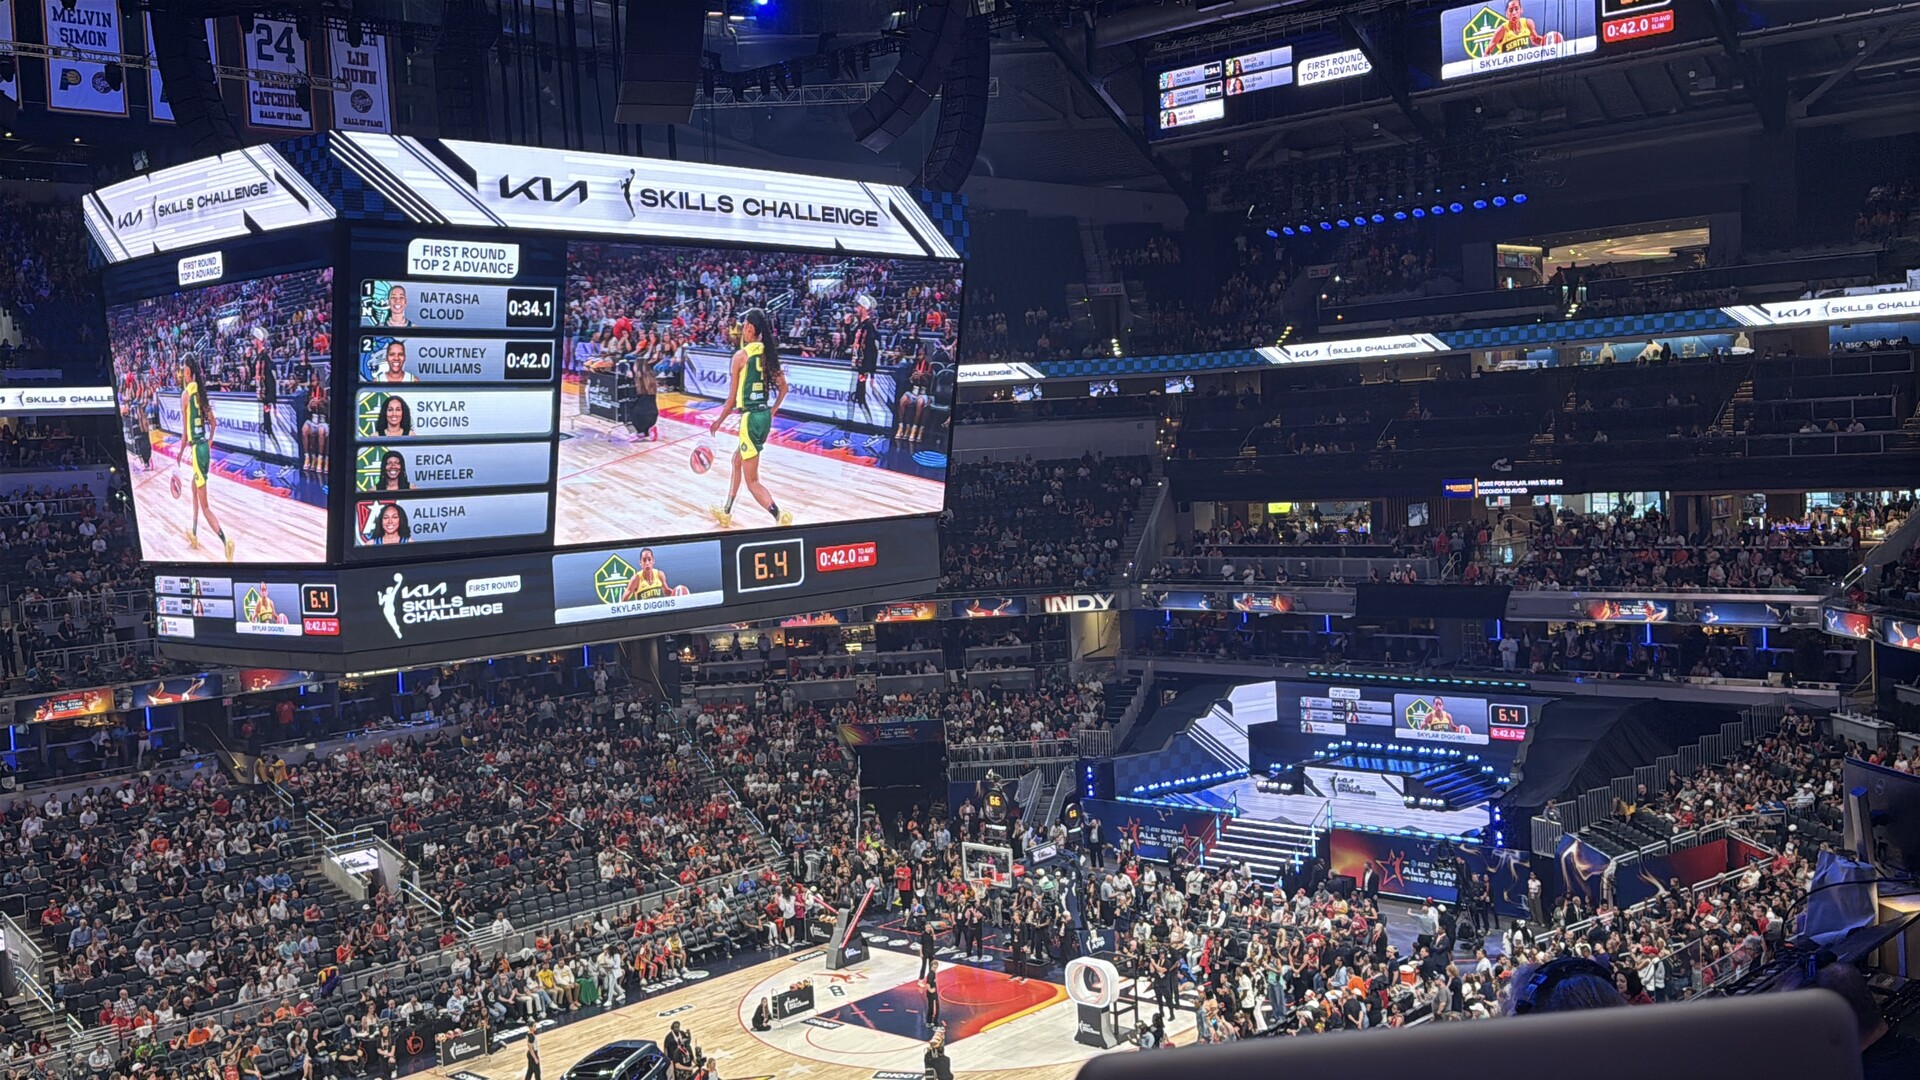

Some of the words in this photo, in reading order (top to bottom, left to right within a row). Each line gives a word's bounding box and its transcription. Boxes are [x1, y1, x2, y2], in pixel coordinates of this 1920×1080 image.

[52, 6, 112, 28] MELVIN
[1607, 19, 1649, 37] 0:42.0
[60, 27, 107, 47] SIMON
[256, 23, 296, 64] 24
[337, 29, 378, 46] COCH
[347, 51, 370, 67] LIN
[1307, 59, 1331, 71] FIRST
[1332, 52, 1364, 65] ROUND
[1479, 55, 1515, 69] SKYLAR
[1517, 47, 1556, 62] DIGGINS
[342, 67, 377, 85] DUNN
[1302, 71, 1319, 82] TOP
[1320, 69, 1326, 78] 2
[1327, 61, 1370, 77] ADVANCE
[158, 198, 195, 217] SKILLS
[196, 181, 269, 208] CHALLENGE
[500, 174, 588, 204] KIA
[640, 188, 734, 213] SKILLS
[742, 198, 879, 227] CHALLENGE
[422, 245, 458, 257] FIRST
[461, 247, 506, 260] ROUND
[183, 259, 197, 270] FIRST
[197, 257, 217, 267] ROUND
[413, 258, 439, 271] TOP
[442, 260, 450, 272] 2
[453, 261, 514, 275] ADVANCE
[180, 271, 191, 281] TOP
[191, 270, 196, 280] 2
[196, 266, 221, 279] ADVANCE
[364, 283, 372, 294] 1
[420, 292, 480, 305] NATASHA
[420, 307, 464, 320] CLOUD
[508, 300, 551, 316] 0:34.1
[1831, 303, 1874, 313] SKILLS
[1877, 300, 1920, 310] CHALL
[362, 339, 372, 351] 2
[1332, 346, 1362, 355] SKILLS
[1364, 342, 1417, 352] CHALLENGE
[418, 346, 486, 359] COURTNEY
[506, 353, 550, 368] 0:42.0
[418, 362, 482, 374] WILLIAMS
[958, 369, 1012, 378] CHALLENGE
[25, 395, 66, 404] SKILLS
[416, 400, 466, 412] SKYLAR
[416, 416, 470, 428] DIGGINS
[415, 454, 453, 466] ERICA
[415, 468, 474, 482] WHEELER
[413, 505, 466, 519] ALLISHA
[413, 521, 448, 534] GRAY
[819, 549, 856, 566] 0:42.0
[754, 550, 788, 580] 6.4
[402, 581, 447, 599] KIA
[468, 582, 490, 592] FIRST
[491, 580, 519, 591] ROUND
[309, 590, 329, 609] 6.4
[402, 595, 464, 613] SKILLS
[611, 603, 642, 614] SKYLAR
[643, 599, 676, 610] DIGGINS
[1043, 593, 1115, 613] INDY
[402, 602, 504, 624] CHALLENGE
[305, 622, 327, 632] 0:42.0
[1498, 708, 1519, 722] 6.4
[1417, 731, 1439, 739] SKYLAR
[1441, 733, 1466, 741] DIGGINS
[1492, 729, 1515, 737] 0:42.0
[1138, 832, 1158, 841] ALL
[1160, 834, 1185, 844] STAR
[1402, 866, 1426, 876] ALL
[1410, 876, 1429, 884] INDY
[877, 1072, 922, 1080] SHOOT
